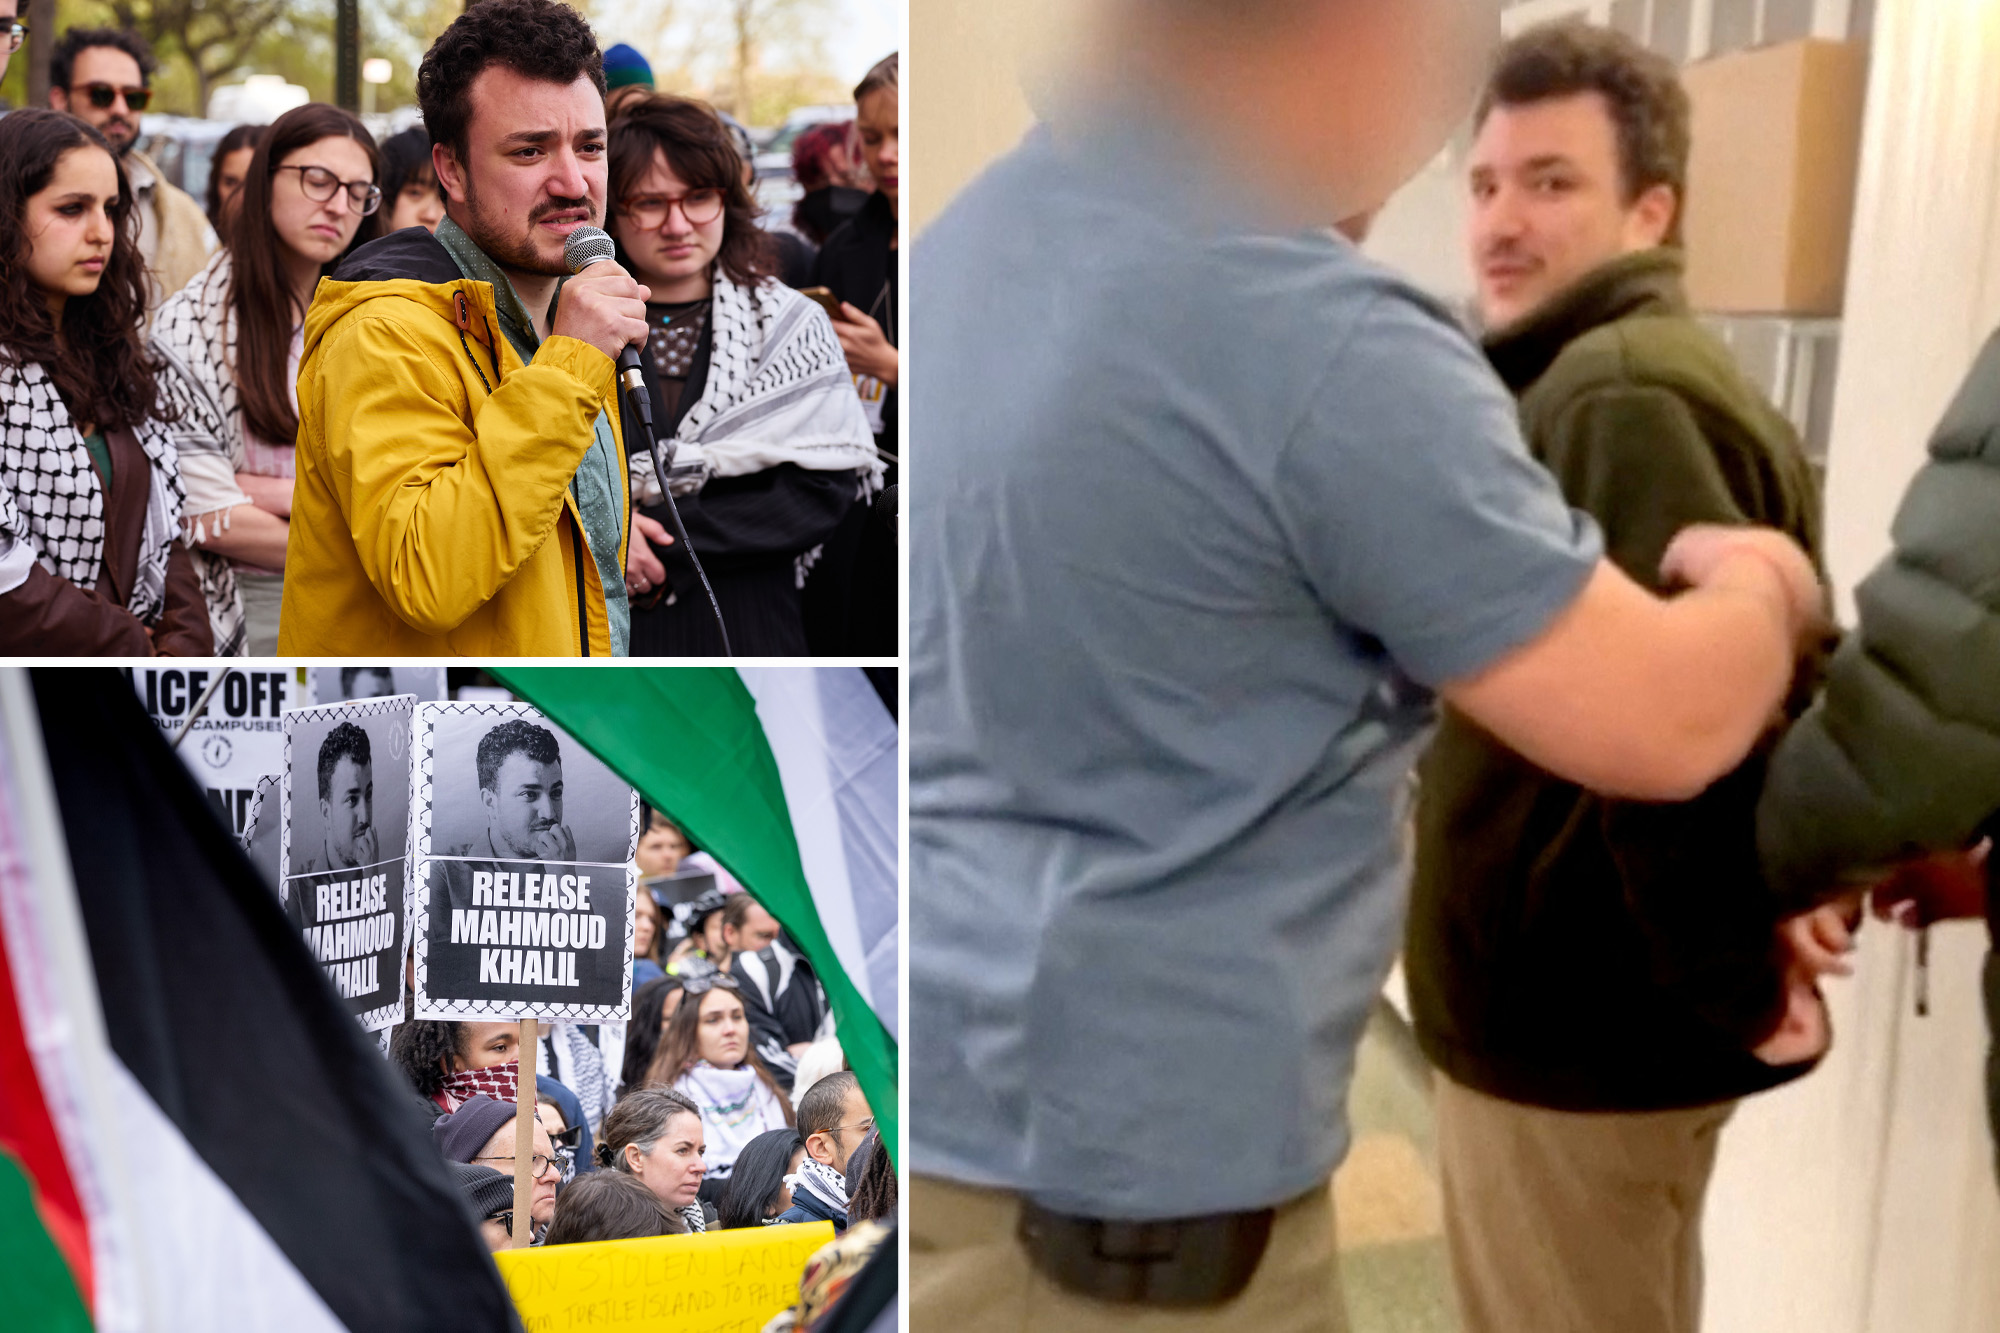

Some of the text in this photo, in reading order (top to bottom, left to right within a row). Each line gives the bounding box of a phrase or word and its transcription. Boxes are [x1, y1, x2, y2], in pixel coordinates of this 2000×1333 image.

[146, 669, 287, 718] ICE OFF
[316, 873, 387, 922] RELEASE
[472, 871, 591, 910] RELEASE
[303, 912, 396, 962] MAHMOUD
[450, 909, 607, 950] MAHMOUD
[479, 948, 580, 987] KHALIL
[507, 1258, 561, 1301] ON
[577, 1248, 708, 1292] STOLEN
[721, 1281, 743, 1305] TO
